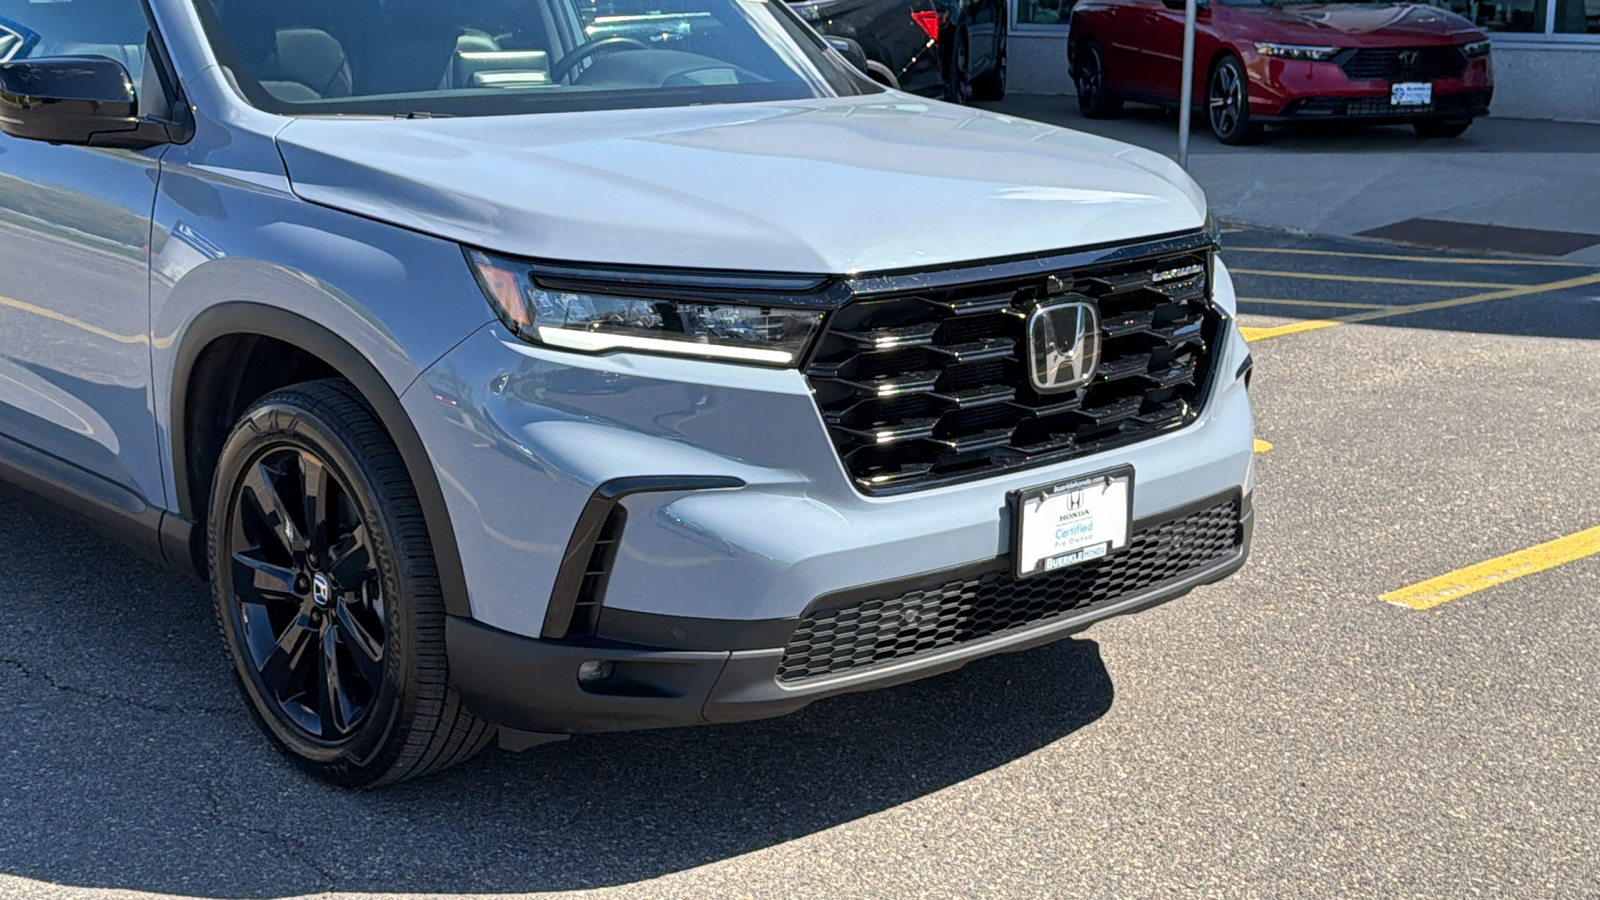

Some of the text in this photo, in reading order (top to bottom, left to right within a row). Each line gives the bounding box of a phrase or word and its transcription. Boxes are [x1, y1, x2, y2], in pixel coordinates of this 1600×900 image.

[1059, 509, 1090, 522] HONDA
[1055, 520, 1093, 540] Certified
[1046, 546, 1105, 570] BUERKLE HONDA
